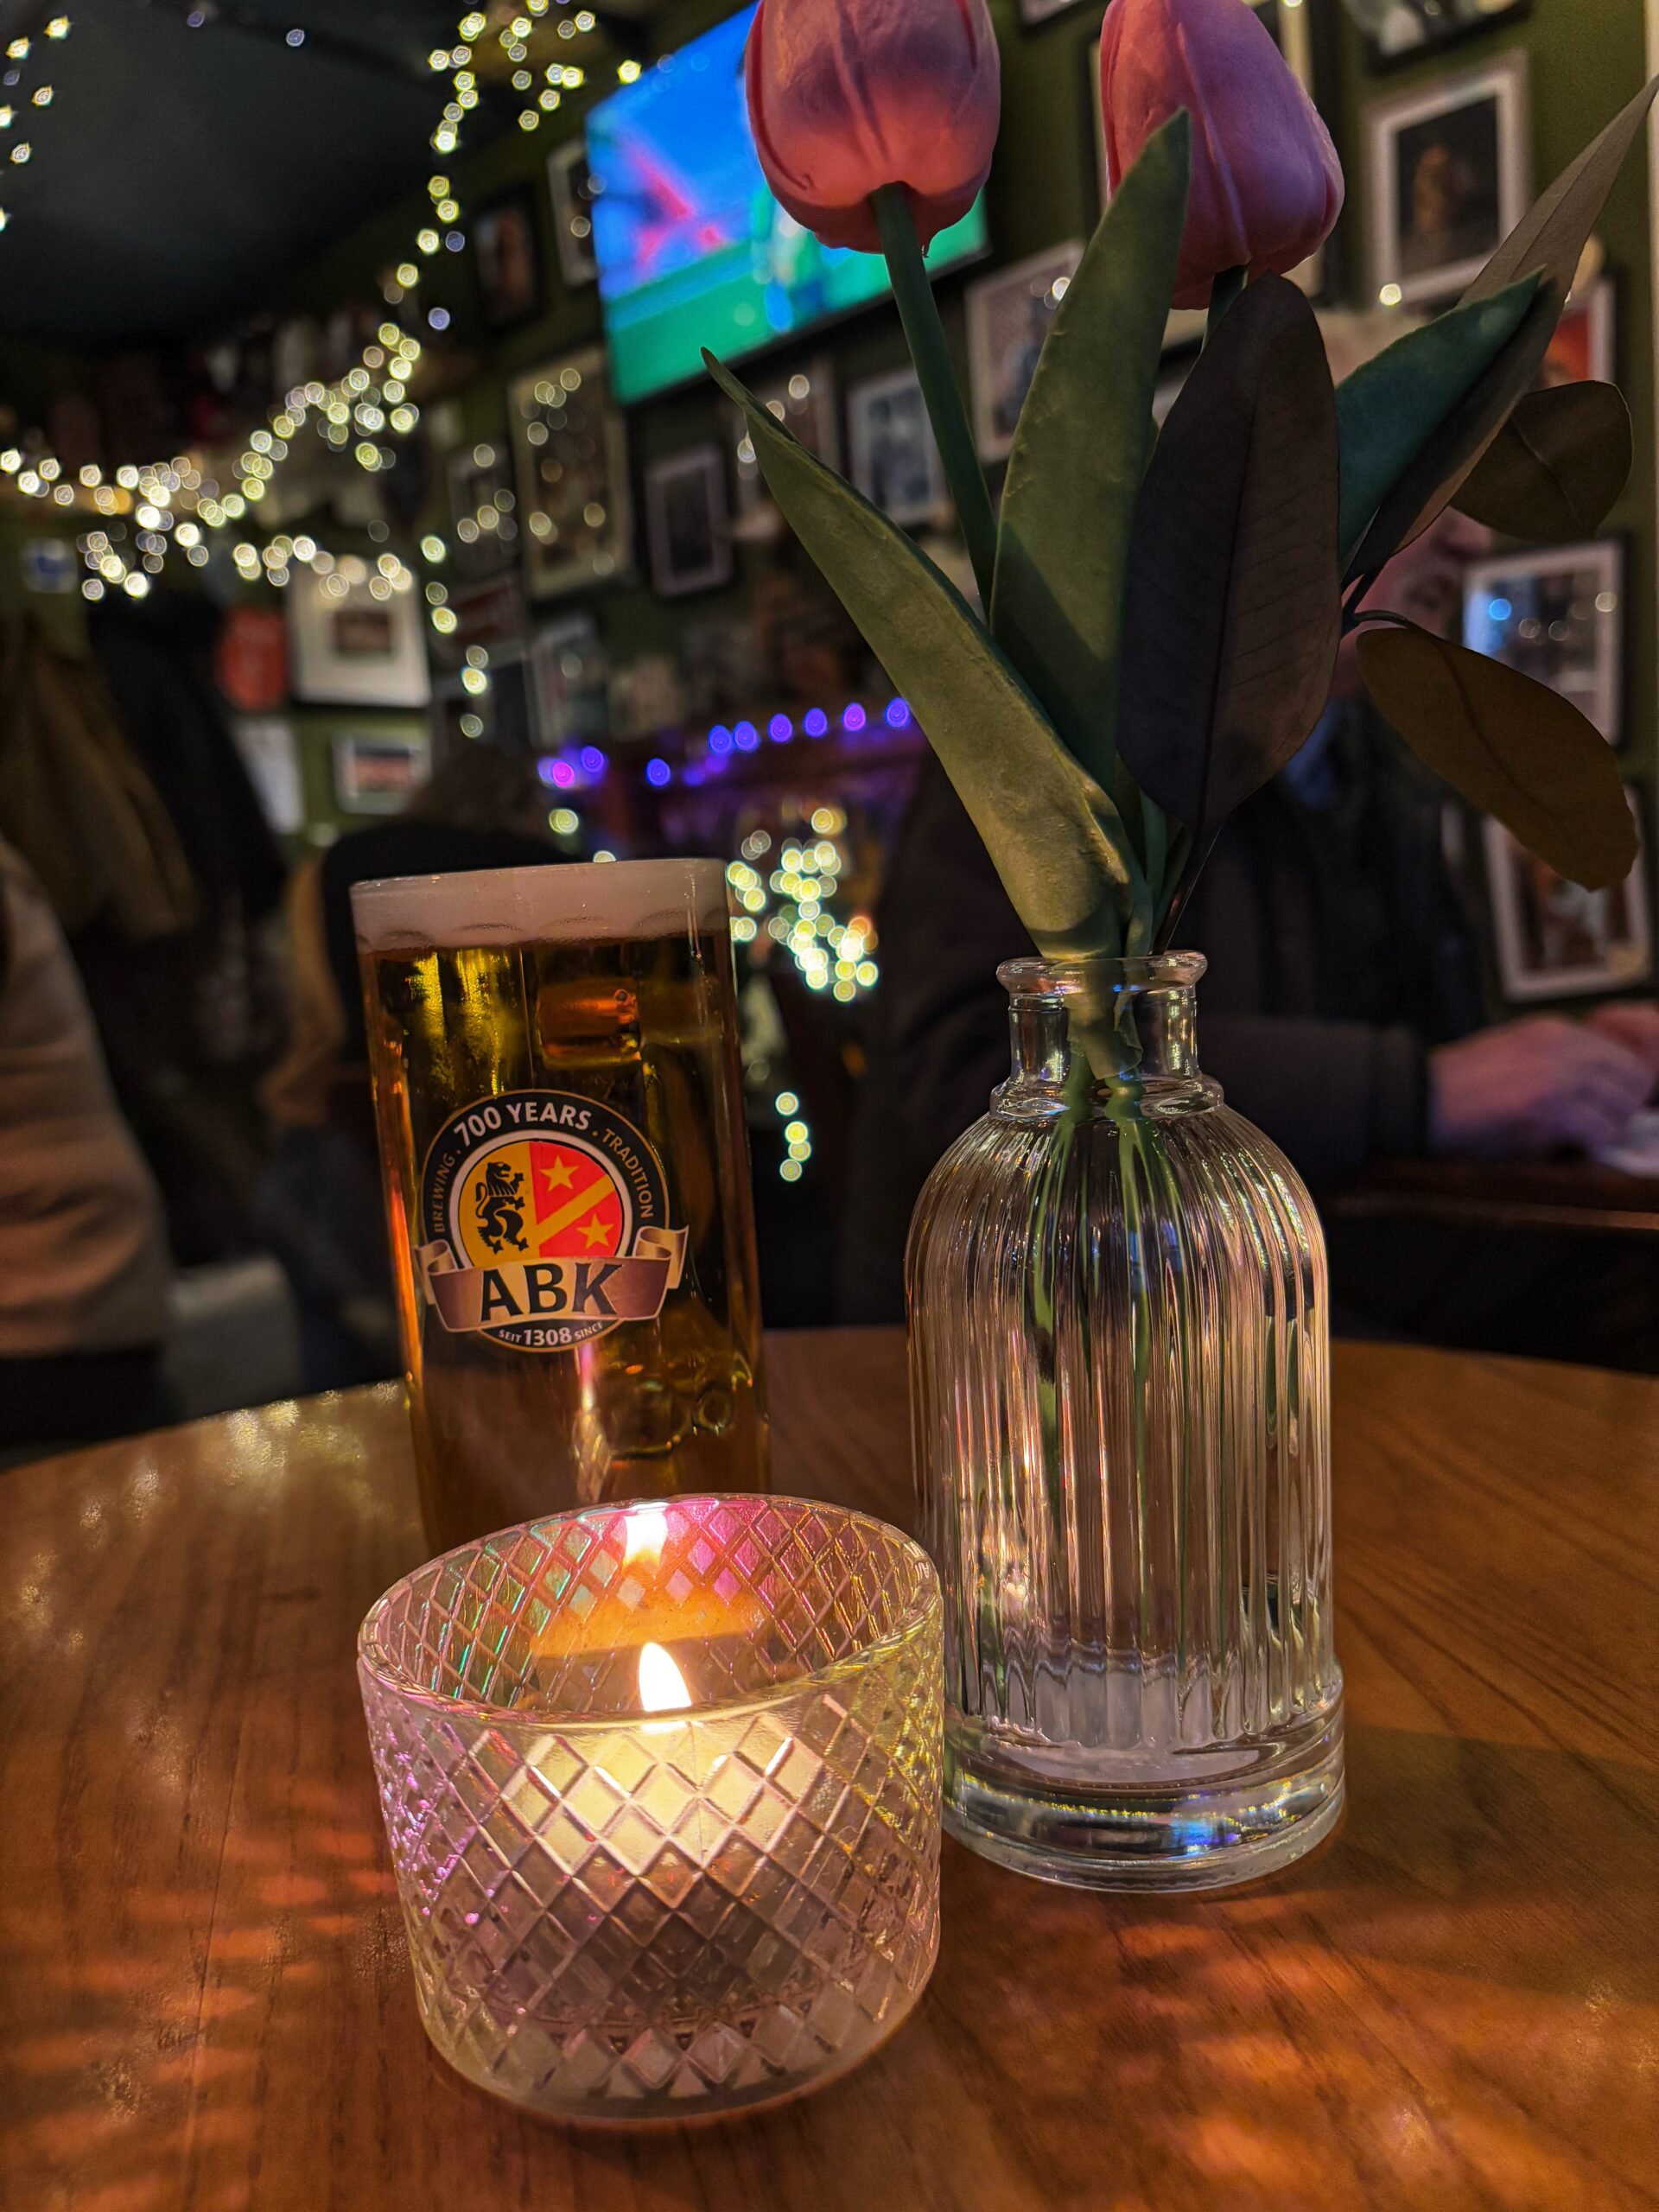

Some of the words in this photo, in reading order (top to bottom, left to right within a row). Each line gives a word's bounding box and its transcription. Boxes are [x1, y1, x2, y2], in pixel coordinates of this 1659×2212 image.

[432, 1153, 456, 1233] BREWING
[454, 1106, 502, 1147] 700
[505, 1102, 592, 1130] YEARS
[602, 1128, 653, 1218] TRADITION
[480, 1262, 623, 1322] ABK
[499, 1329, 522, 1344] SEIT
[524, 1327, 572, 1346] 1308
